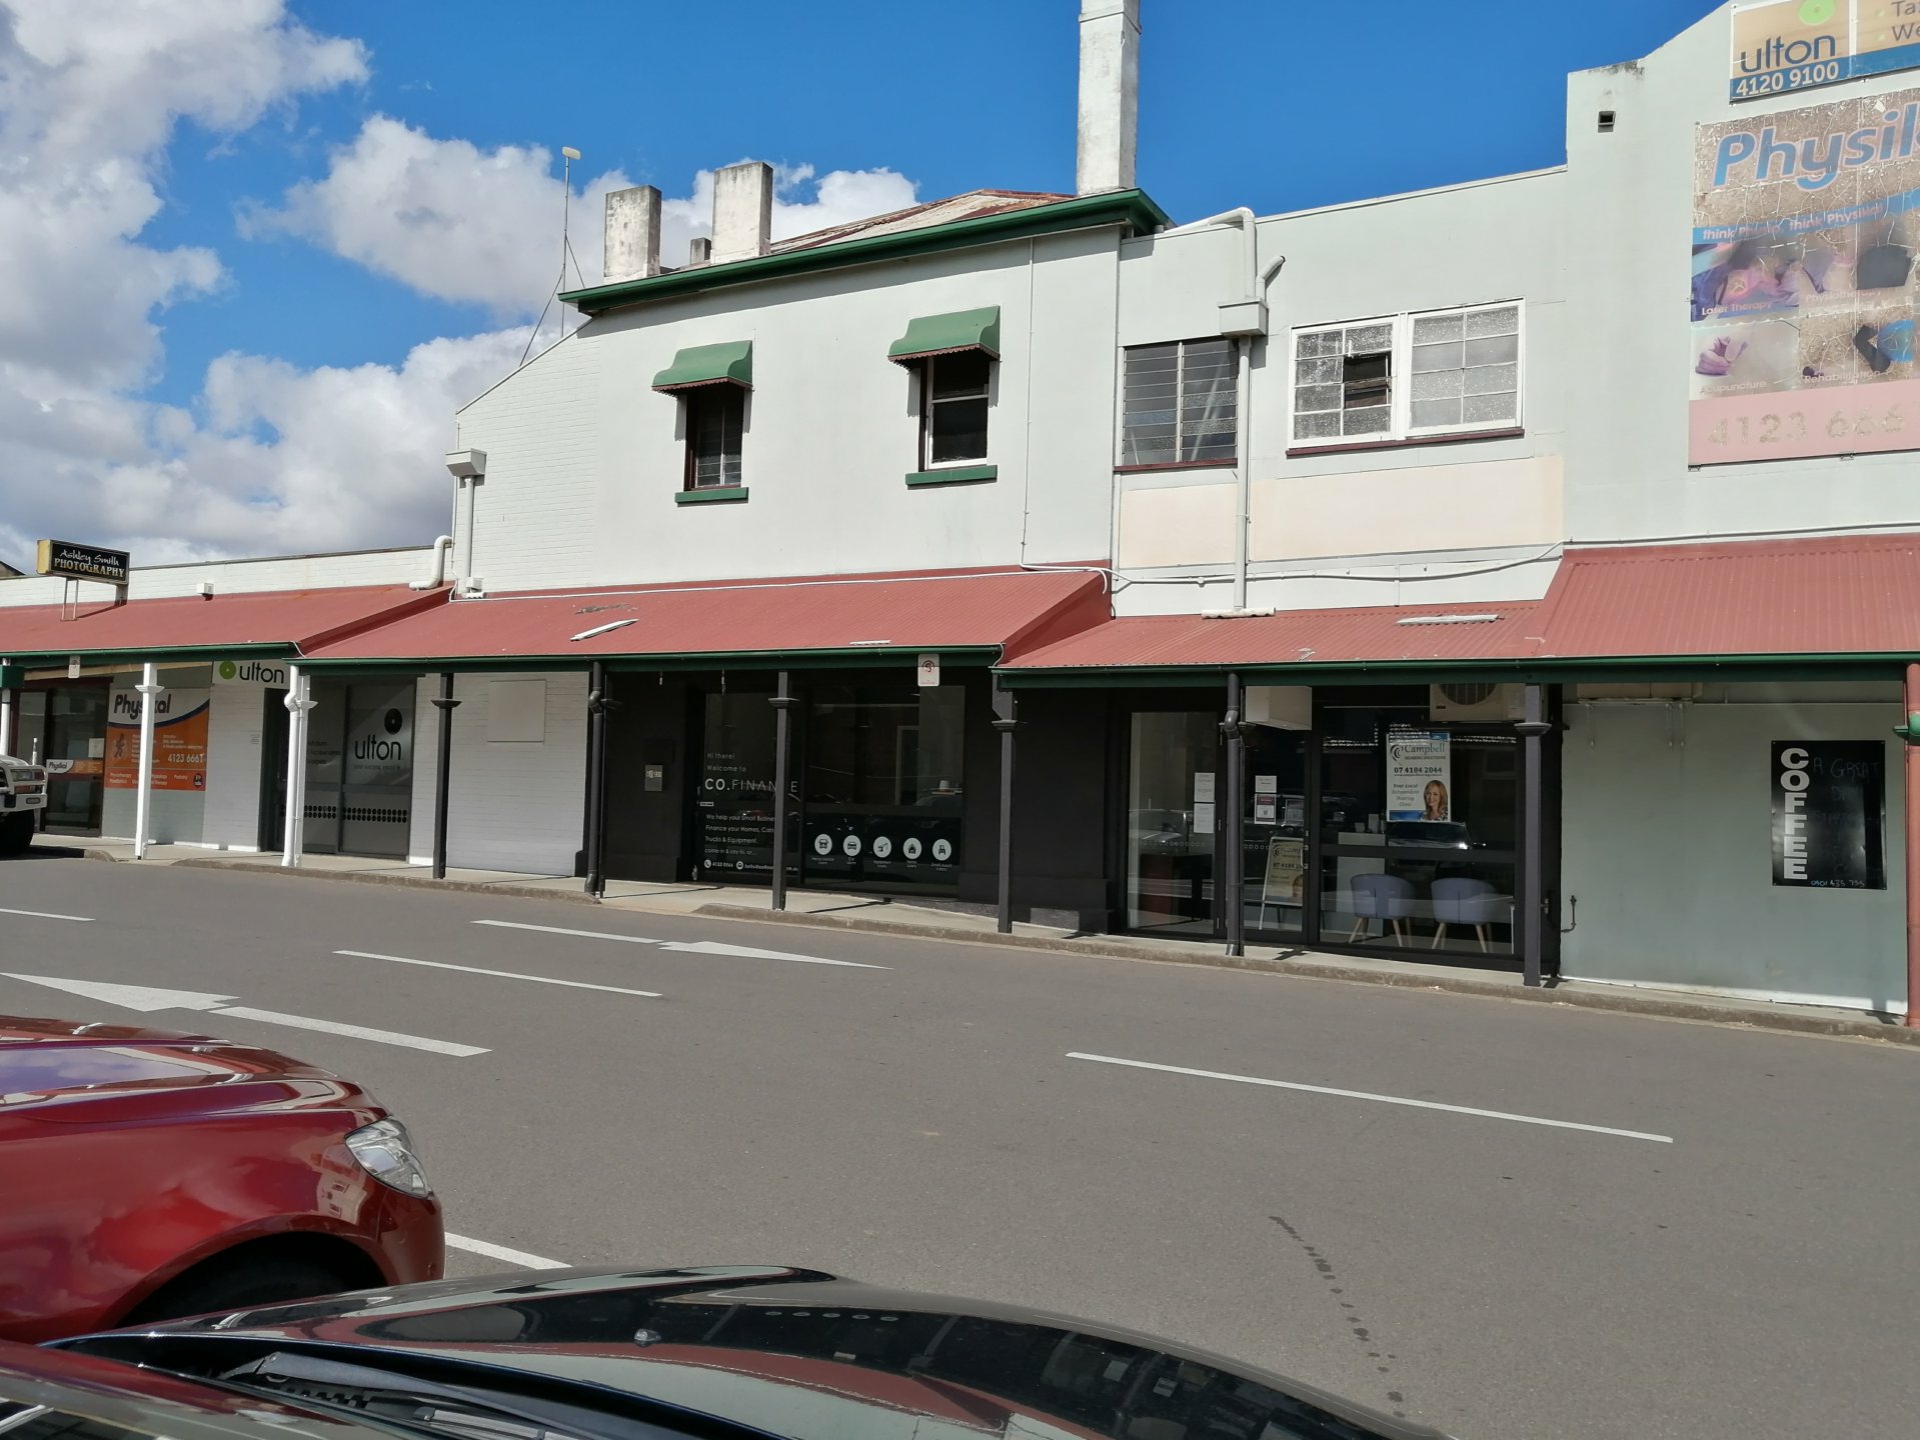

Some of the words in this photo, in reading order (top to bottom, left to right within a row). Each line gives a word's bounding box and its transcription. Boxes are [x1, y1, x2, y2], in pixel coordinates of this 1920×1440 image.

[1890, 0, 1920, 17] Ta
[1740, 35, 1836, 73] ulton
[1736, 73, 1784, 96] 4120
[1789, 62, 1839, 87] 9100
[1703, 227, 1736, 240] think
[1789, 216, 1822, 231] think
[1708, 411, 1807, 446] 4123
[1825, 402, 1920, 439] 666
[54, 558, 125, 578] PHOTOGRAPHY
[60, 549, 91, 567] Ashley
[94, 554, 120, 567] Smith
[239, 662, 284, 684] ulton
[354, 733, 402, 760] ulton
[1404, 743, 1445, 755] Campbell
[167, 753, 185, 763] 4123
[739, 765, 747, 773] to
[704, 778, 799, 793] CO.FINANE
[1780, 747, 1810, 880] COFFEE
